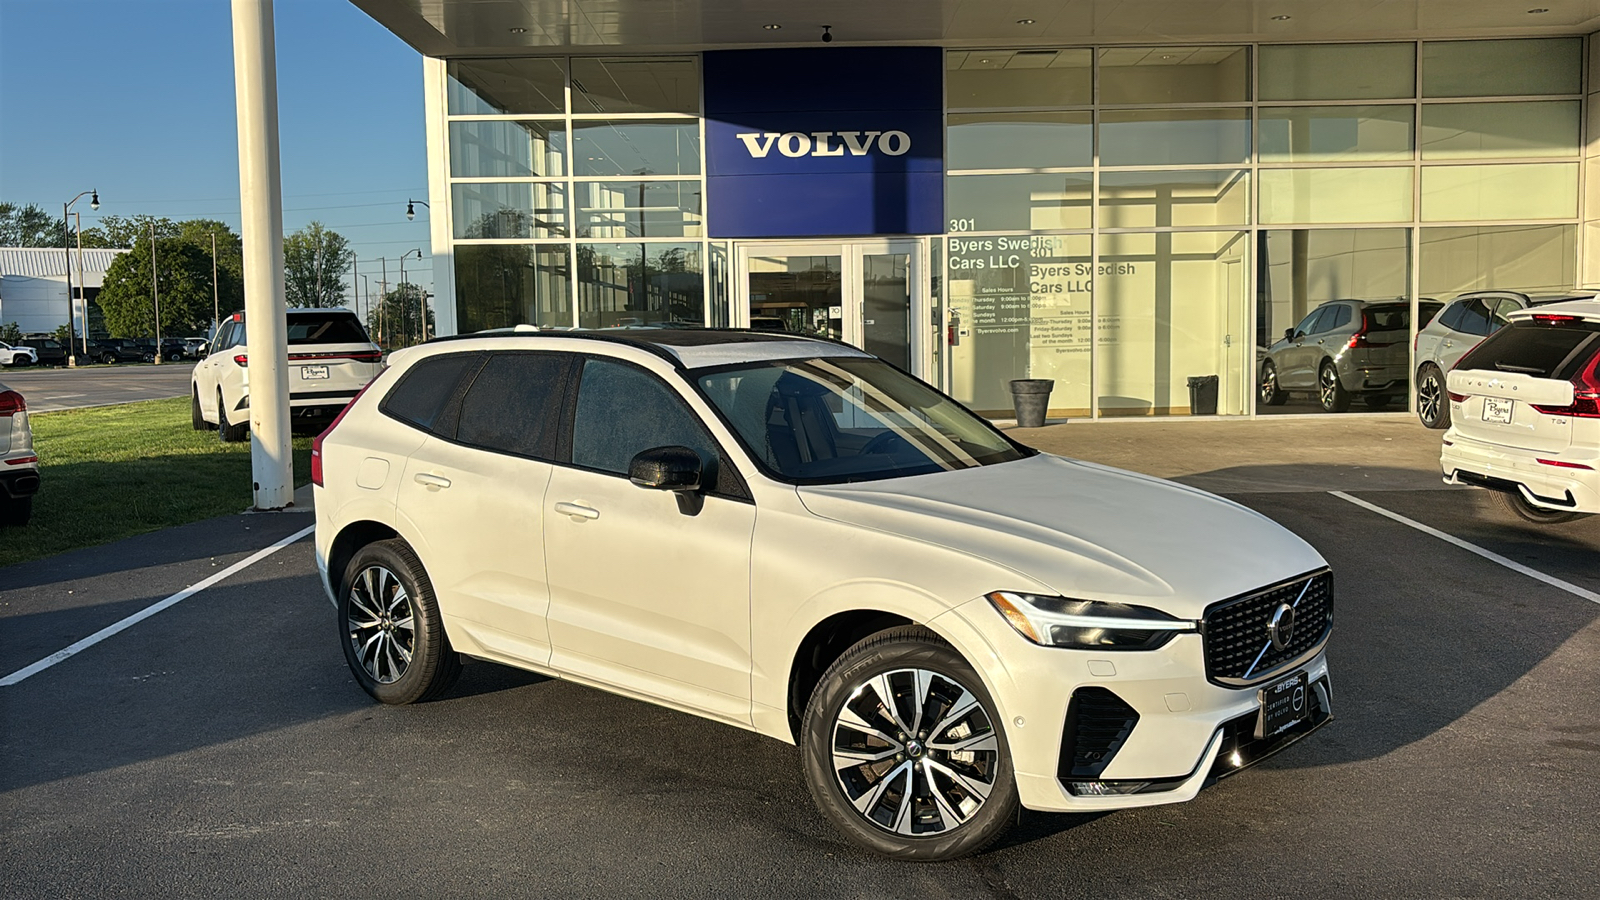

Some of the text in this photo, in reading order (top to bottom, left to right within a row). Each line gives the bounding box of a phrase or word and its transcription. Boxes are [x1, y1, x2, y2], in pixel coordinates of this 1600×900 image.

[736, 130, 911, 158] VOLVO
[950, 219, 975, 231] 301
[950, 236, 1063, 255] Byers Swedish
[950, 254, 1020, 270] Cars LLC
[1030, 265, 1070, 280] Byers
[1030, 281, 1063, 293] Cars
[1276, 676, 1299, 693] BYERS
[1267, 696, 1290, 711] CERTIFIED
